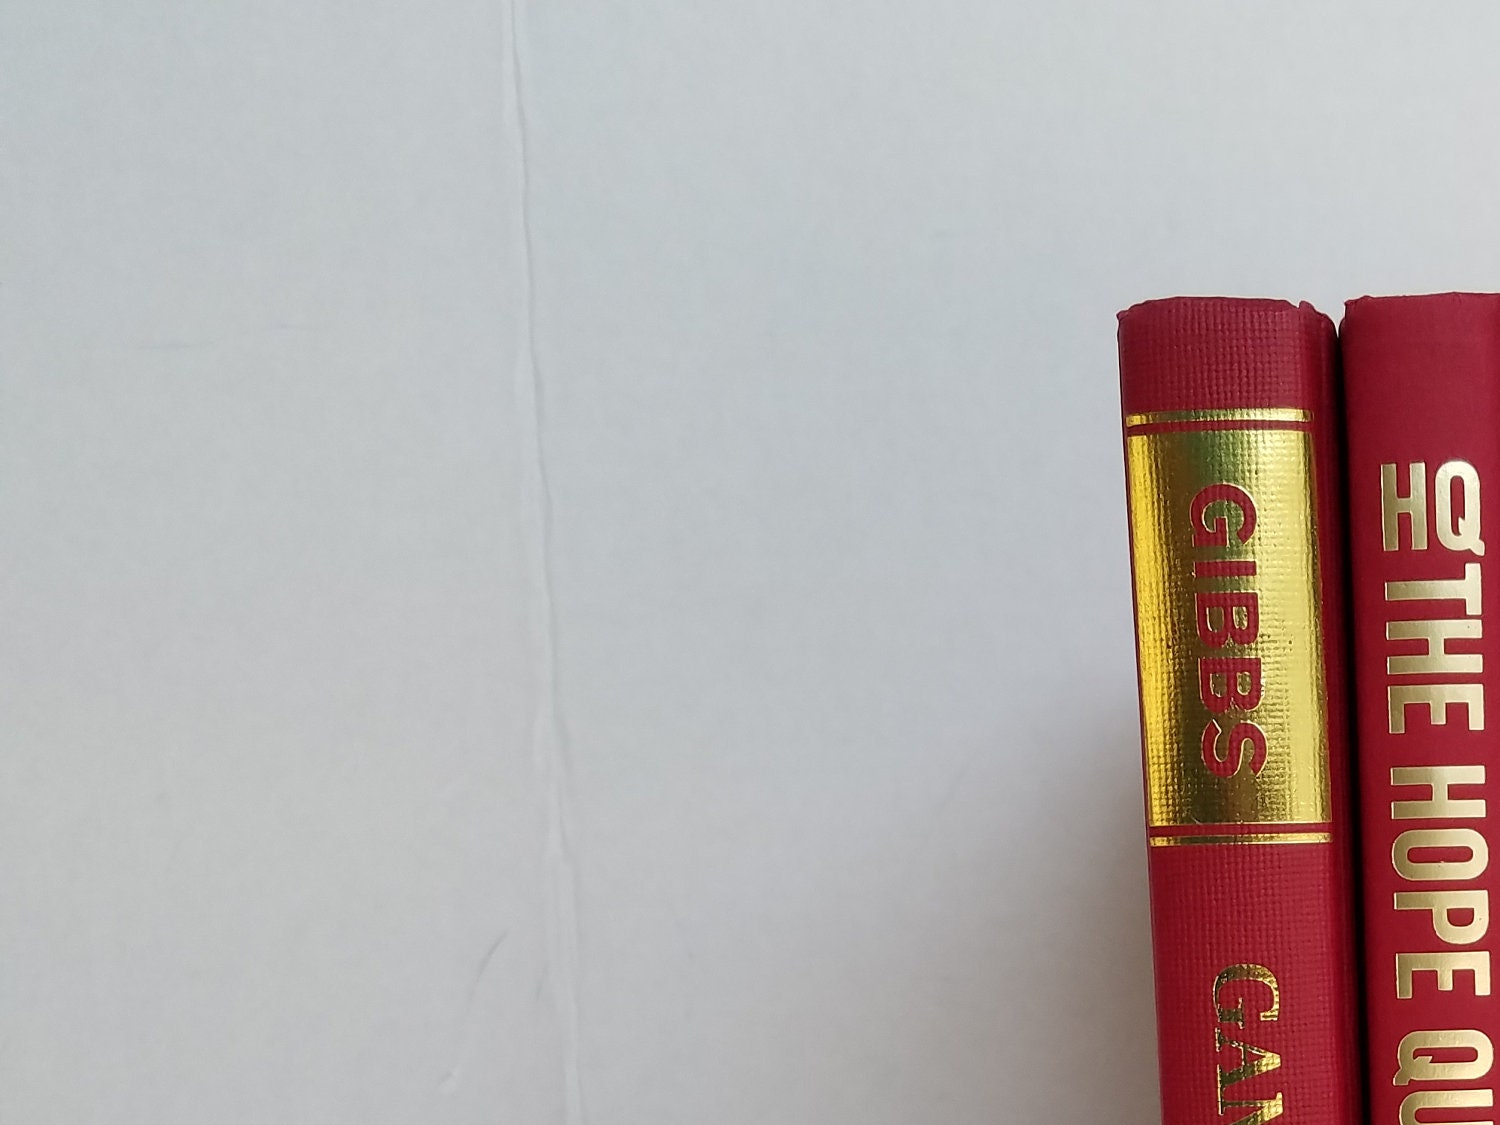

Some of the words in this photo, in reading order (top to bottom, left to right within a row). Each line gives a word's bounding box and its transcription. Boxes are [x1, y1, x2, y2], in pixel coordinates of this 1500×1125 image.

[1380, 458, 1486, 557] HQ
[1189, 481, 1267, 778] GIBBS
[1384, 562, 1485, 734] THE
[1389, 764, 1492, 1000] HOPE
